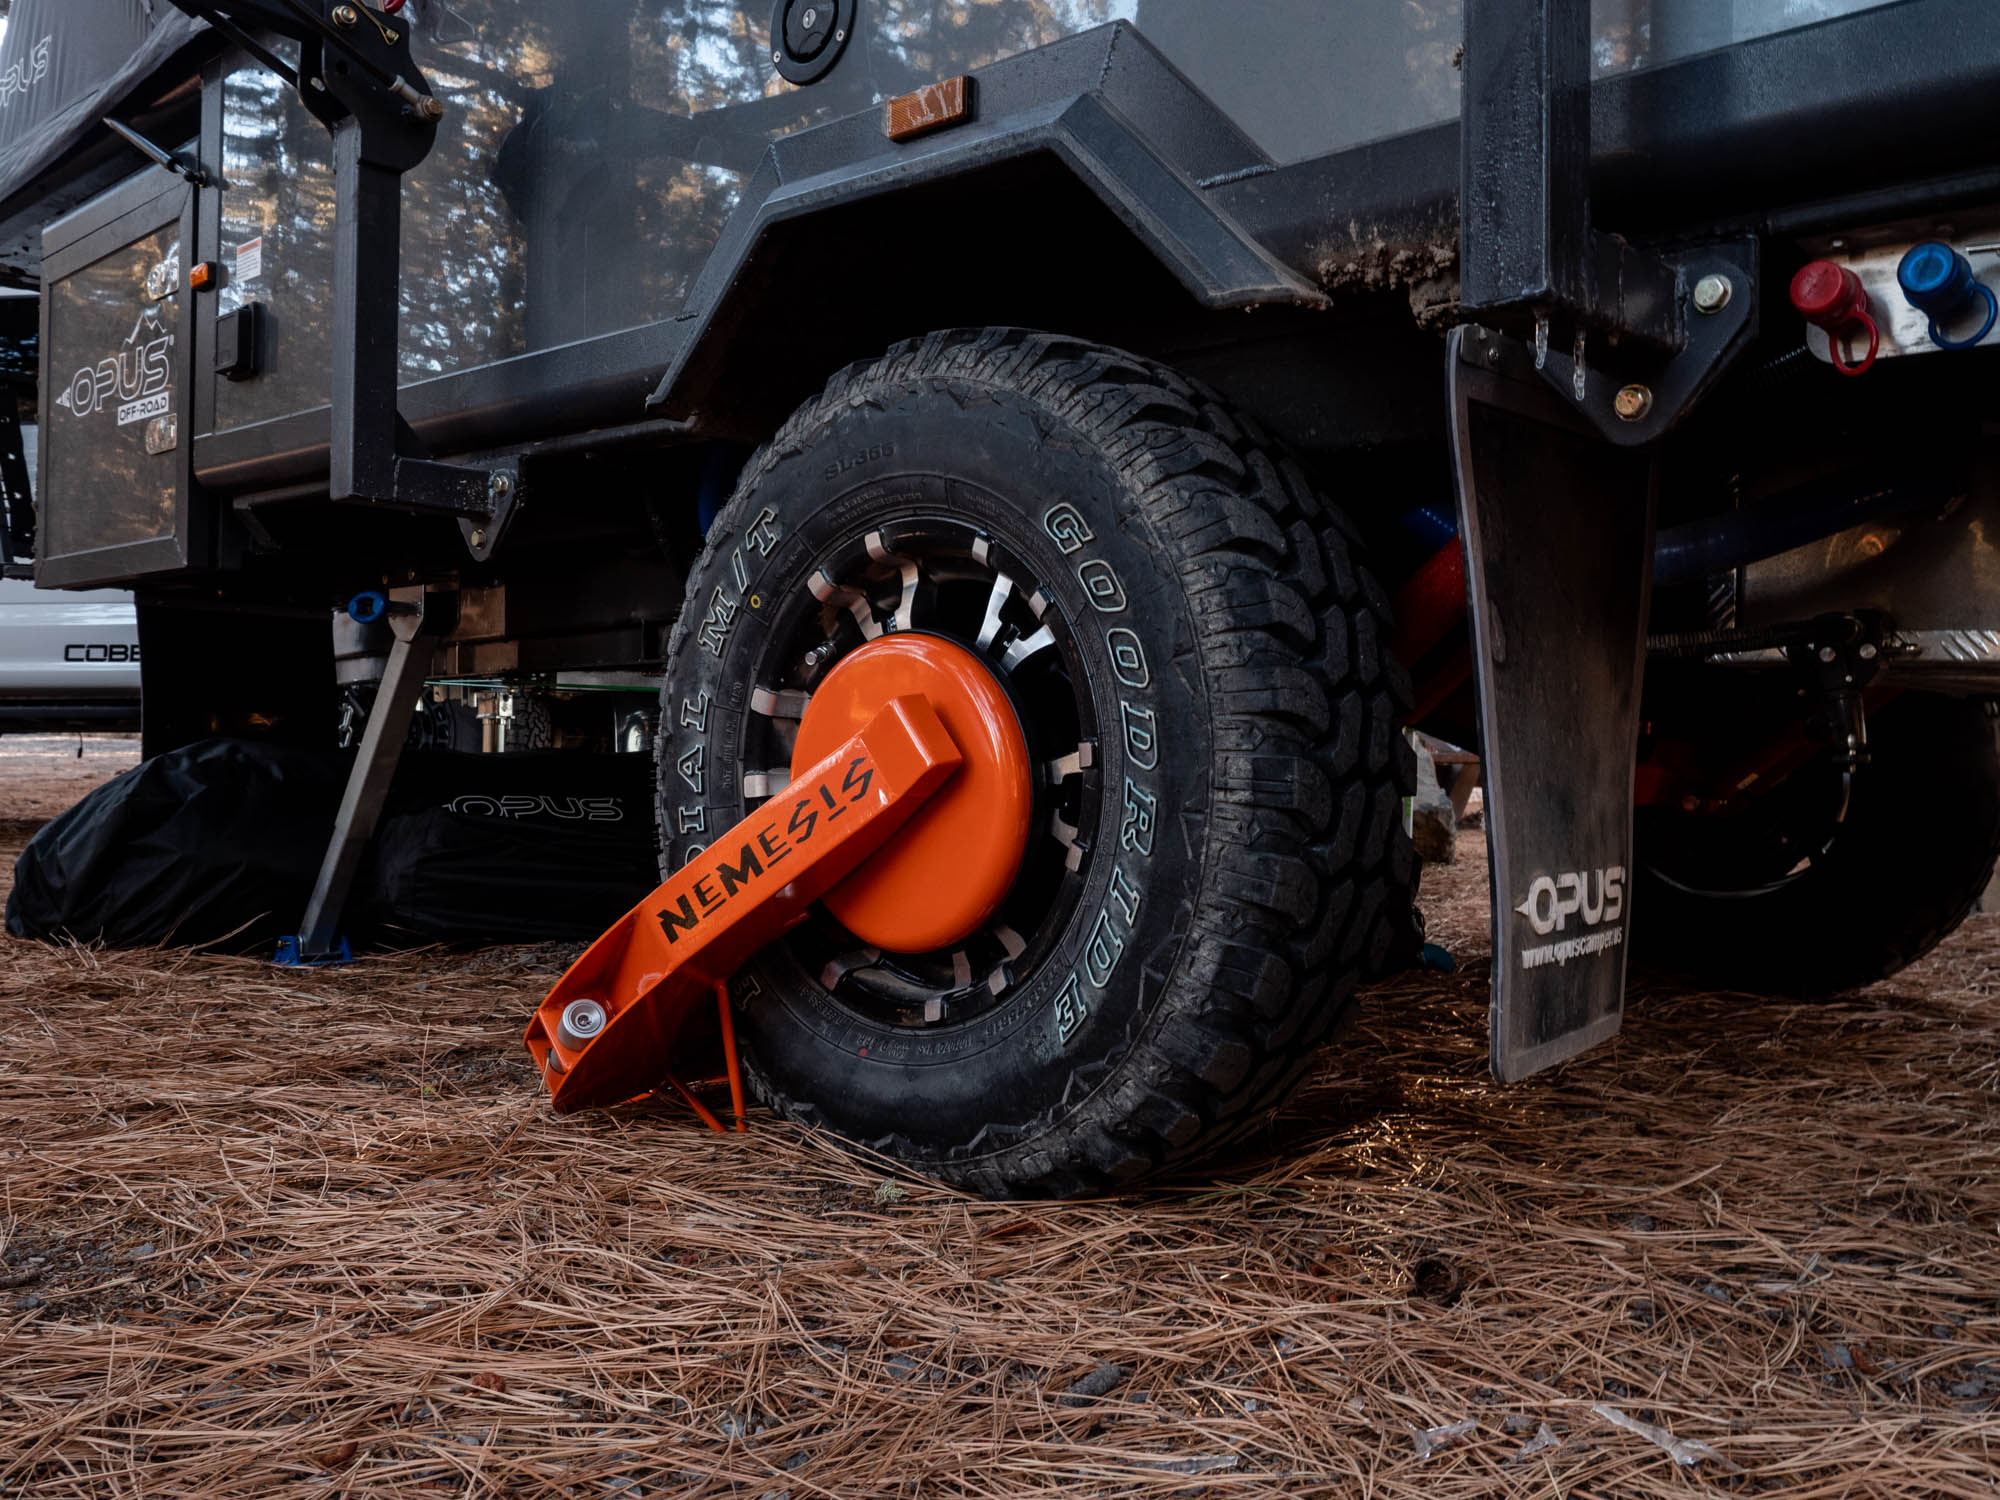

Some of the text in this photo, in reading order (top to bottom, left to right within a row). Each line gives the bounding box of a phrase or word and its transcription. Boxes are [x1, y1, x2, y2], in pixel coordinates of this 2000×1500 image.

[0, 35, 50, 108] PUS
[70, 335, 170, 417] OPUS
[119, 396, 168, 422] OFF-ROAD
[697, 506, 778, 657] M/T
[1044, 502, 1158, 1046] GOODRIDE
[656, 757, 874, 945] NEMESIS
[1527, 865, 1625, 936] OPUS
